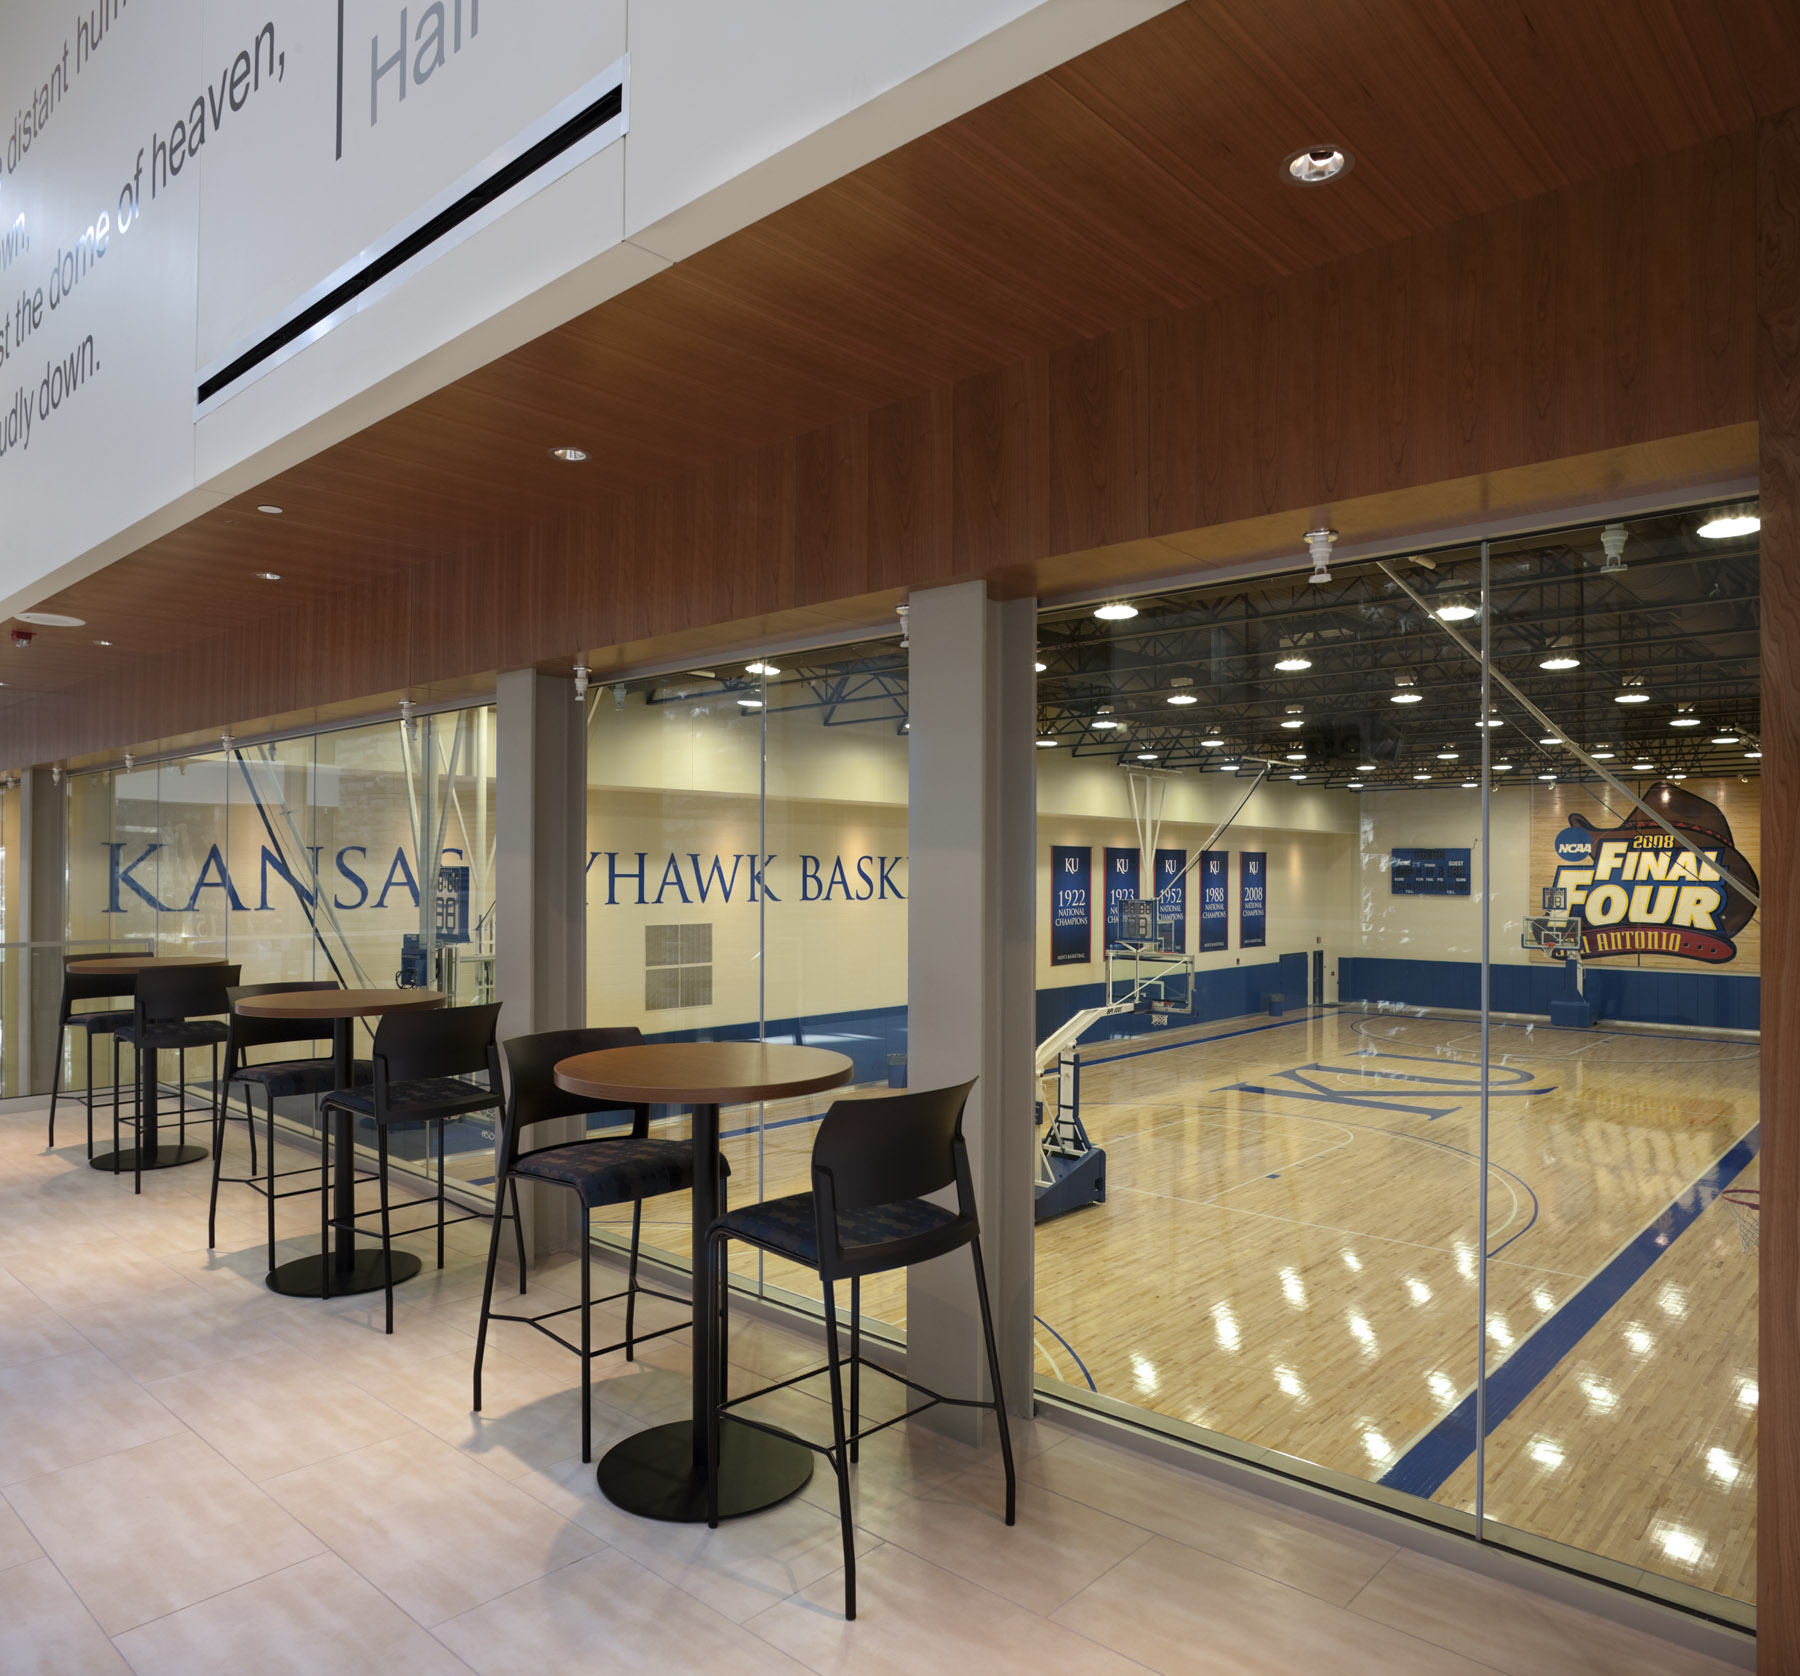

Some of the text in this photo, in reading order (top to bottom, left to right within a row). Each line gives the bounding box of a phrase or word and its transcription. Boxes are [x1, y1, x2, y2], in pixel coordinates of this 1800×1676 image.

[7, 39, 69, 175] distant
[16, 286, 43, 349] the
[49, 209, 109, 311] dome
[117, 147, 144, 234] of
[151, 21, 286, 200] heaven,
[0, 211, 30, 272] wn,
[39, 333, 101, 422] down.
[1558, 843, 1592, 854] NCAA
[1633, 834, 1674, 849] 2008
[1065, 858, 1079, 874] KU
[1116, 858, 1129, 874] KU
[1165, 859, 1176, 875] KU
[1210, 860, 1220, 875] KU
[1249, 861, 1259, 875] KU
[1595, 841, 1722, 881] FINAL
[799, 854, 909, 902] BASK
[1058, 889, 1086, 907] 1922
[1110, 888, 1135, 905] 1923
[1160, 887, 1182, 903] 1952
[1205, 887, 1224, 902] 1988
[1244, 887, 1263, 901] 2008
[1547, 869, 1721, 931] FOUR
[1058, 908, 1085, 917] NATIONAL
[1159, 904, 1181, 912] NATIONAL
[1202, 911, 1226, 919] CHAMPIONS
[1204, 903, 1224, 911] NATIONAL
[1242, 909, 1264, 917] CHAMPIONS
[1055, 917, 1088, 927] CHAMPIONS
[1158, 912, 1184, 921] CHAMPIONS
[1596, 930, 1681, 952] ANTONIO
